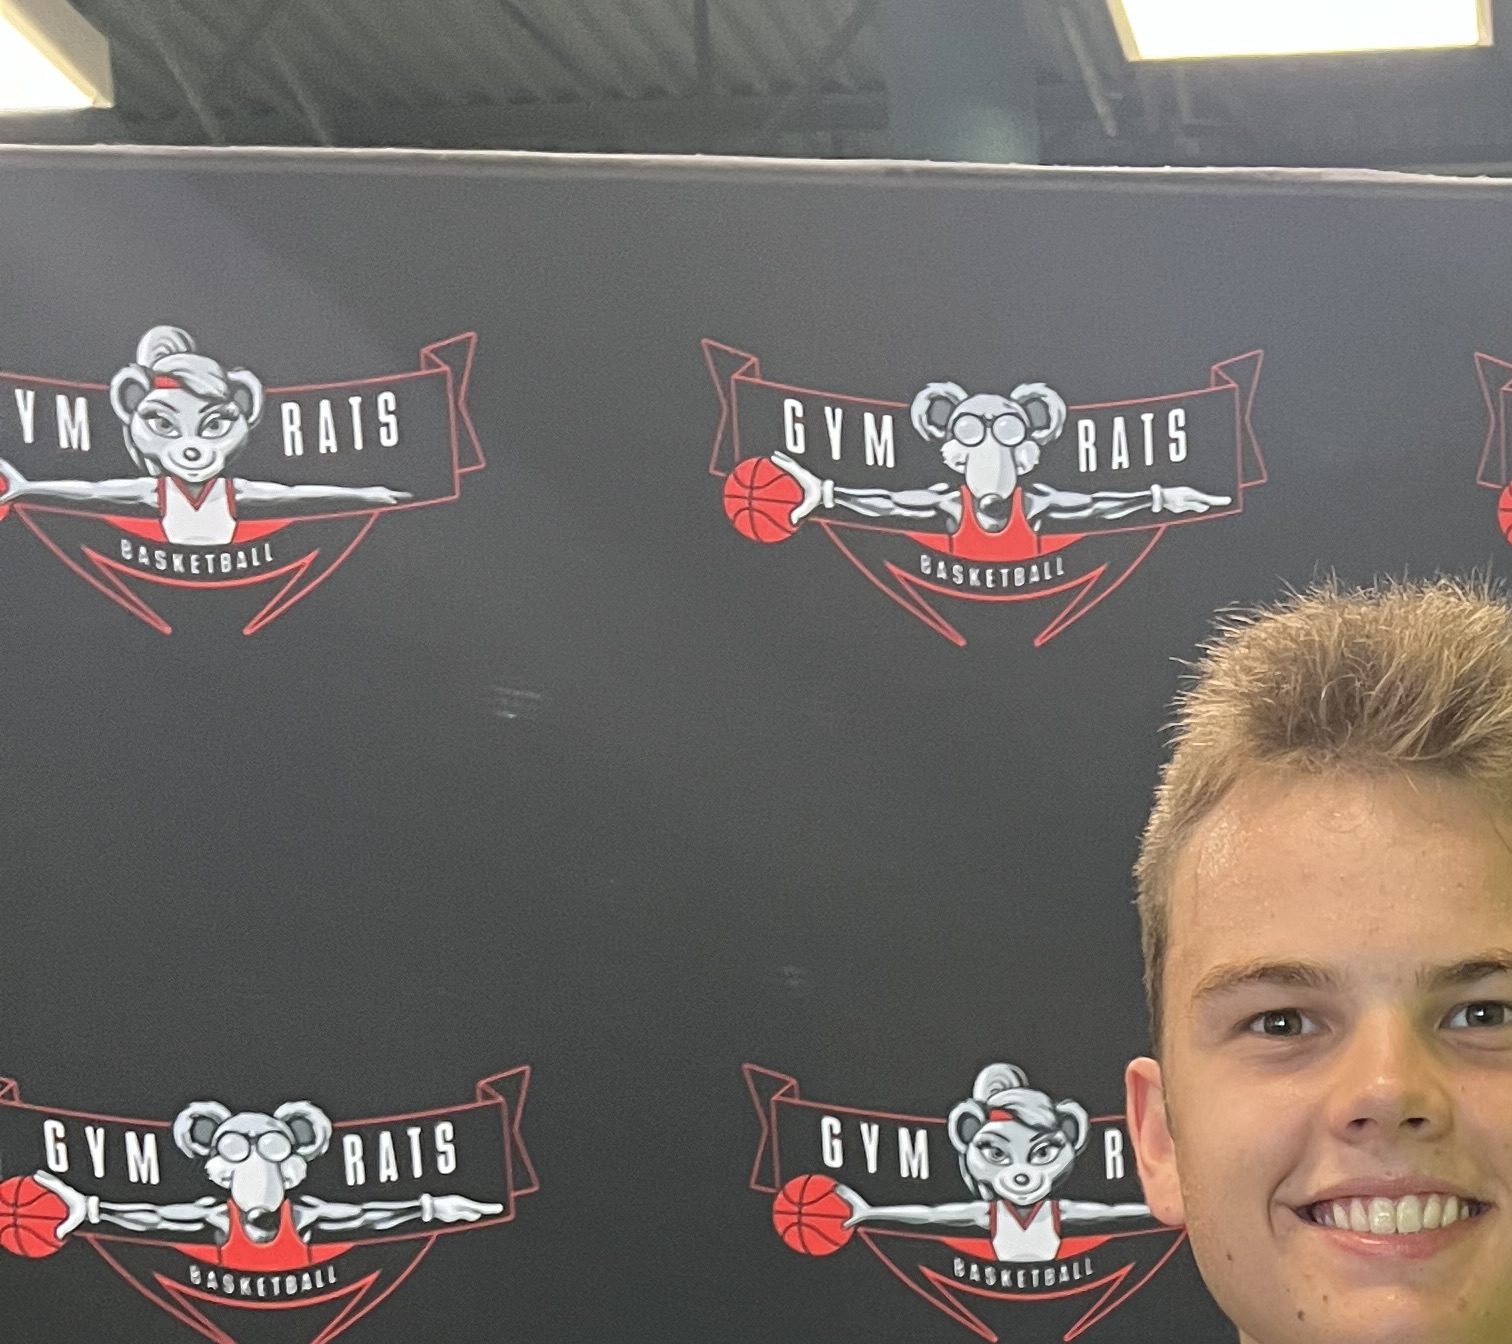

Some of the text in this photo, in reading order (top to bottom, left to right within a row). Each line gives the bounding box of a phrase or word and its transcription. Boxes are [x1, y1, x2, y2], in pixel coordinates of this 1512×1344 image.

[281, 392, 398, 456] RATS
[784, 399, 1186, 472] GYM RATS
[121, 539, 273, 574] BASKETBALL
[921, 555, 1064, 587] BASKETBALL
[44, 1120, 456, 1185] GYM RATS
[821, 1116, 929, 1179] GYM
[190, 1265, 336, 1296] BASKETBALL
[954, 1258, 1092, 1288] BASKETBALL
